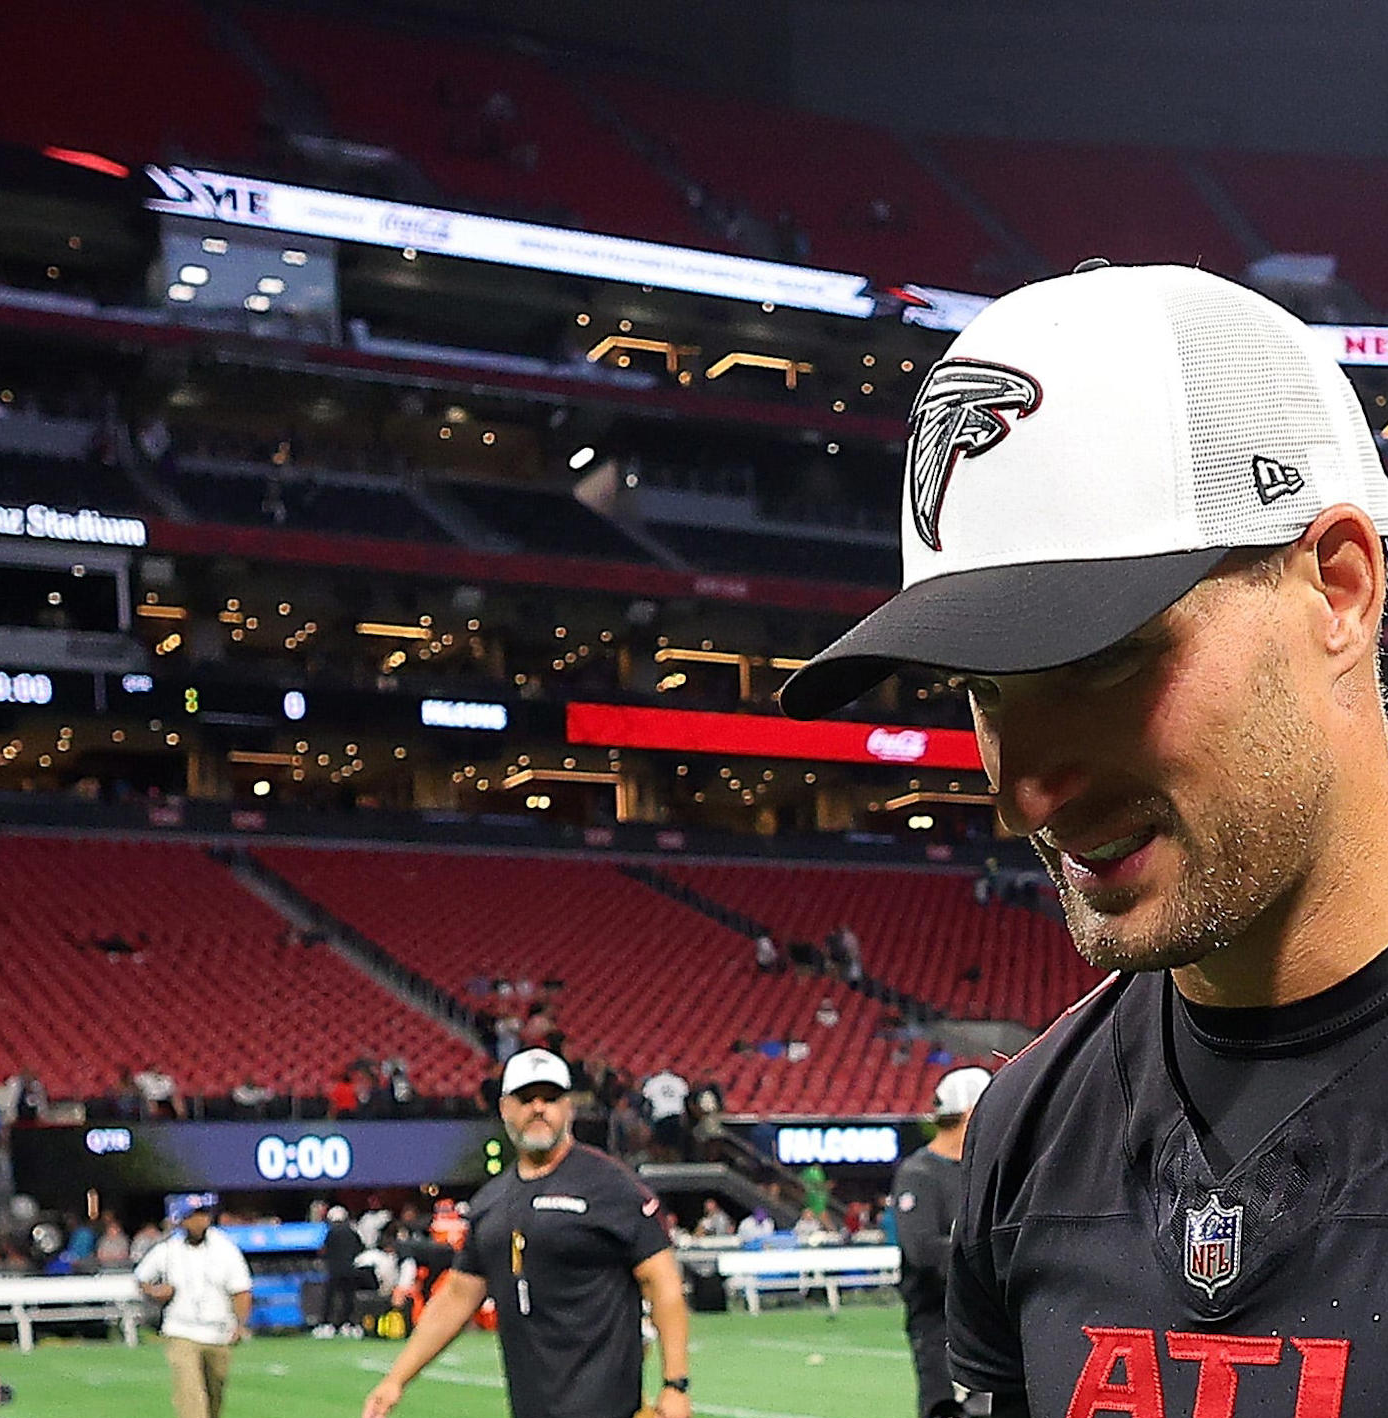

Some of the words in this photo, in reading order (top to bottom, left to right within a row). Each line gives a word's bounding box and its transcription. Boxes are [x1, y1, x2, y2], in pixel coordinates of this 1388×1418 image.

[26, 504, 147, 547] Stadium
[257, 1136, 351, 1181] 0:00
[1191, 1241, 1231, 1280] NFL
